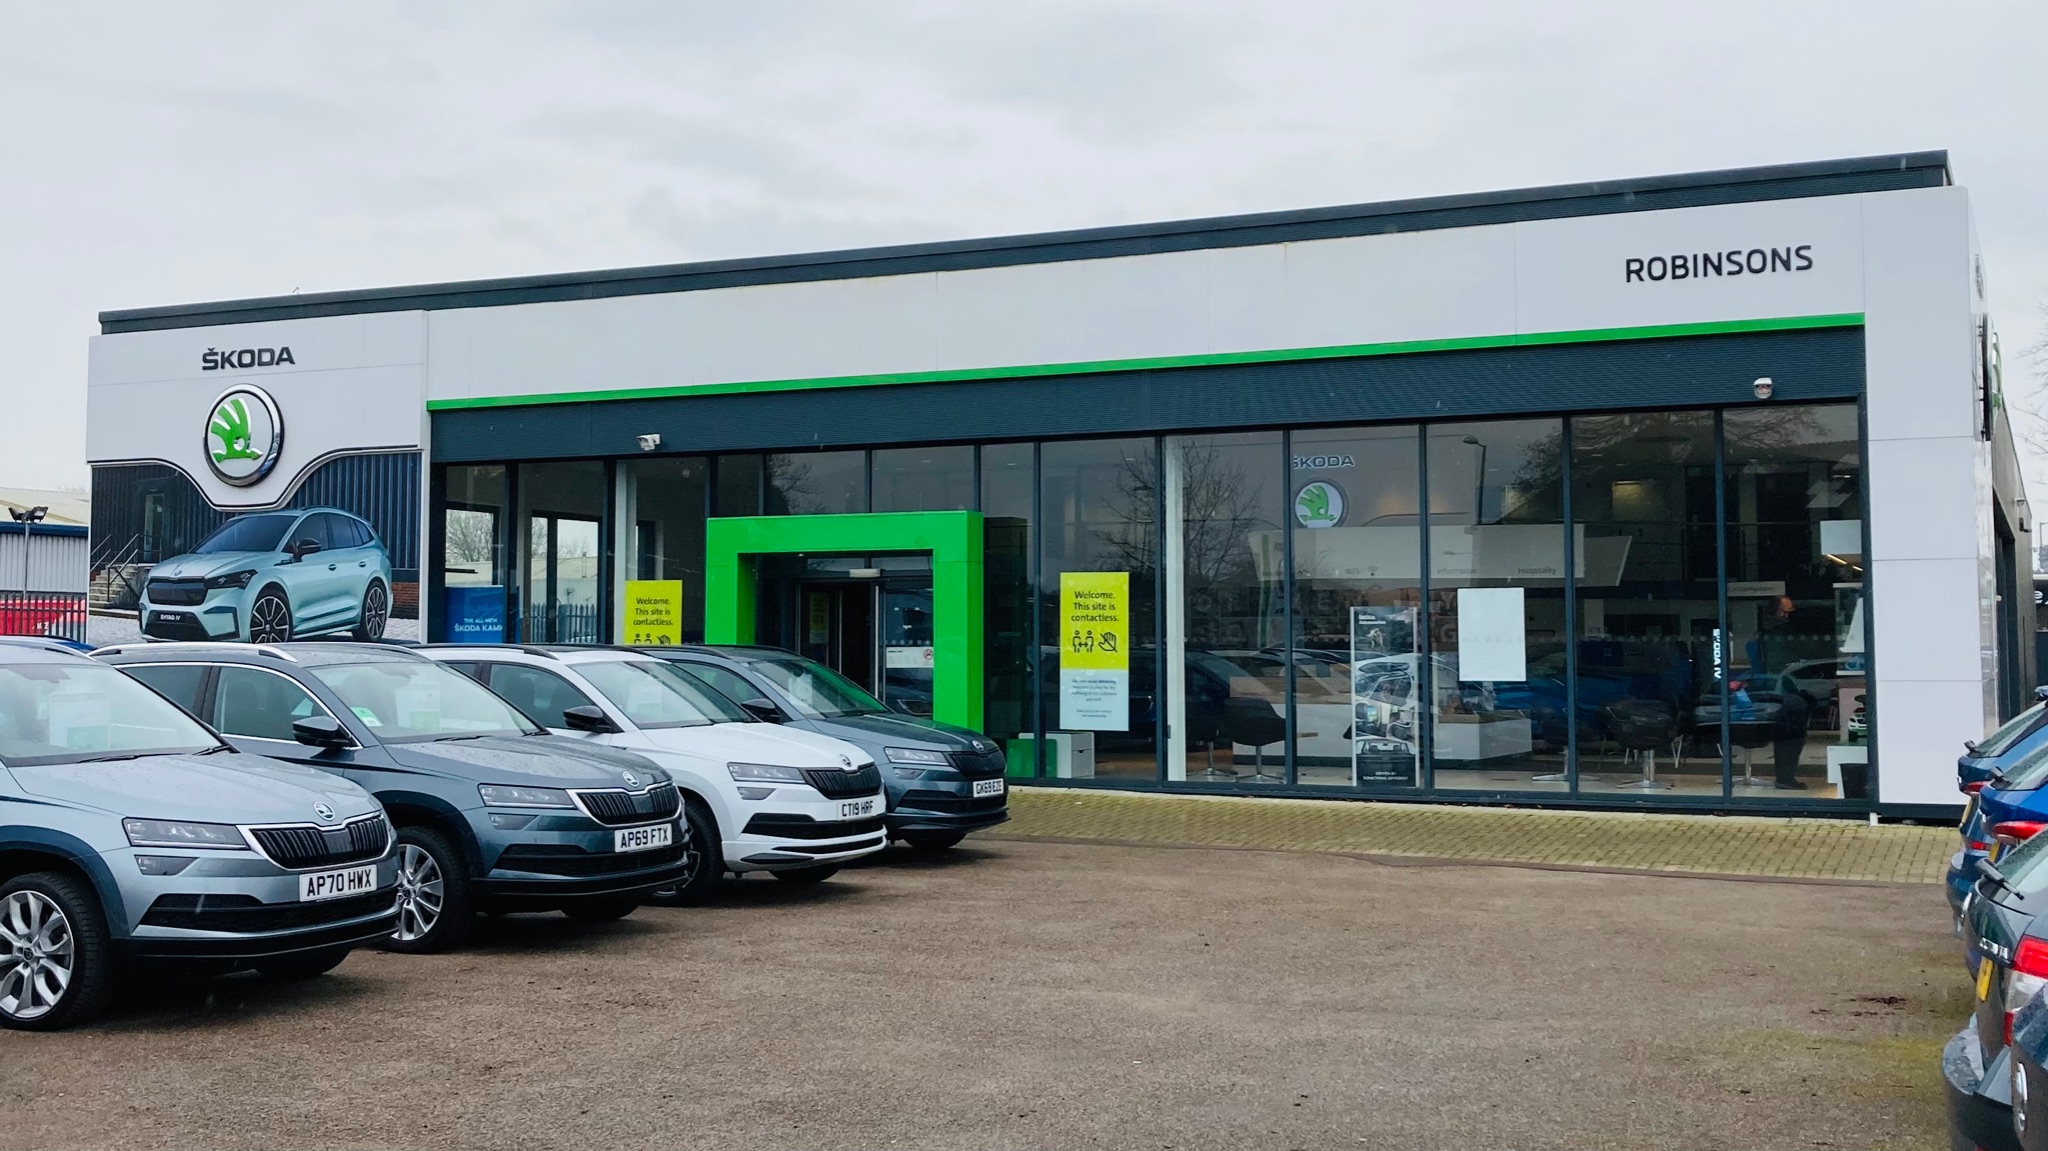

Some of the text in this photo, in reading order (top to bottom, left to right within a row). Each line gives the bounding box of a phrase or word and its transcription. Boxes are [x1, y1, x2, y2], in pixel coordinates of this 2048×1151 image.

[1625, 244, 1814, 283] ROBINSONS
[202, 347, 296, 371] ŠKODA
[1518, 566, 1557, 575] Hospitality
[1074, 590, 1116, 599] Welcome.
[636, 597, 671, 605] Welcome.
[1073, 602, 1116, 611] This site is
[635, 607, 671, 616] This site is
[633, 618, 674, 626] contactless.
[1071, 613, 1119, 622] contactless.
[454, 623, 481, 632] ŠKODA
[842, 802, 860, 817] CT19
[620, 826, 669, 849] AP69 FTX
[307, 868, 372, 897] AP70 HWX
